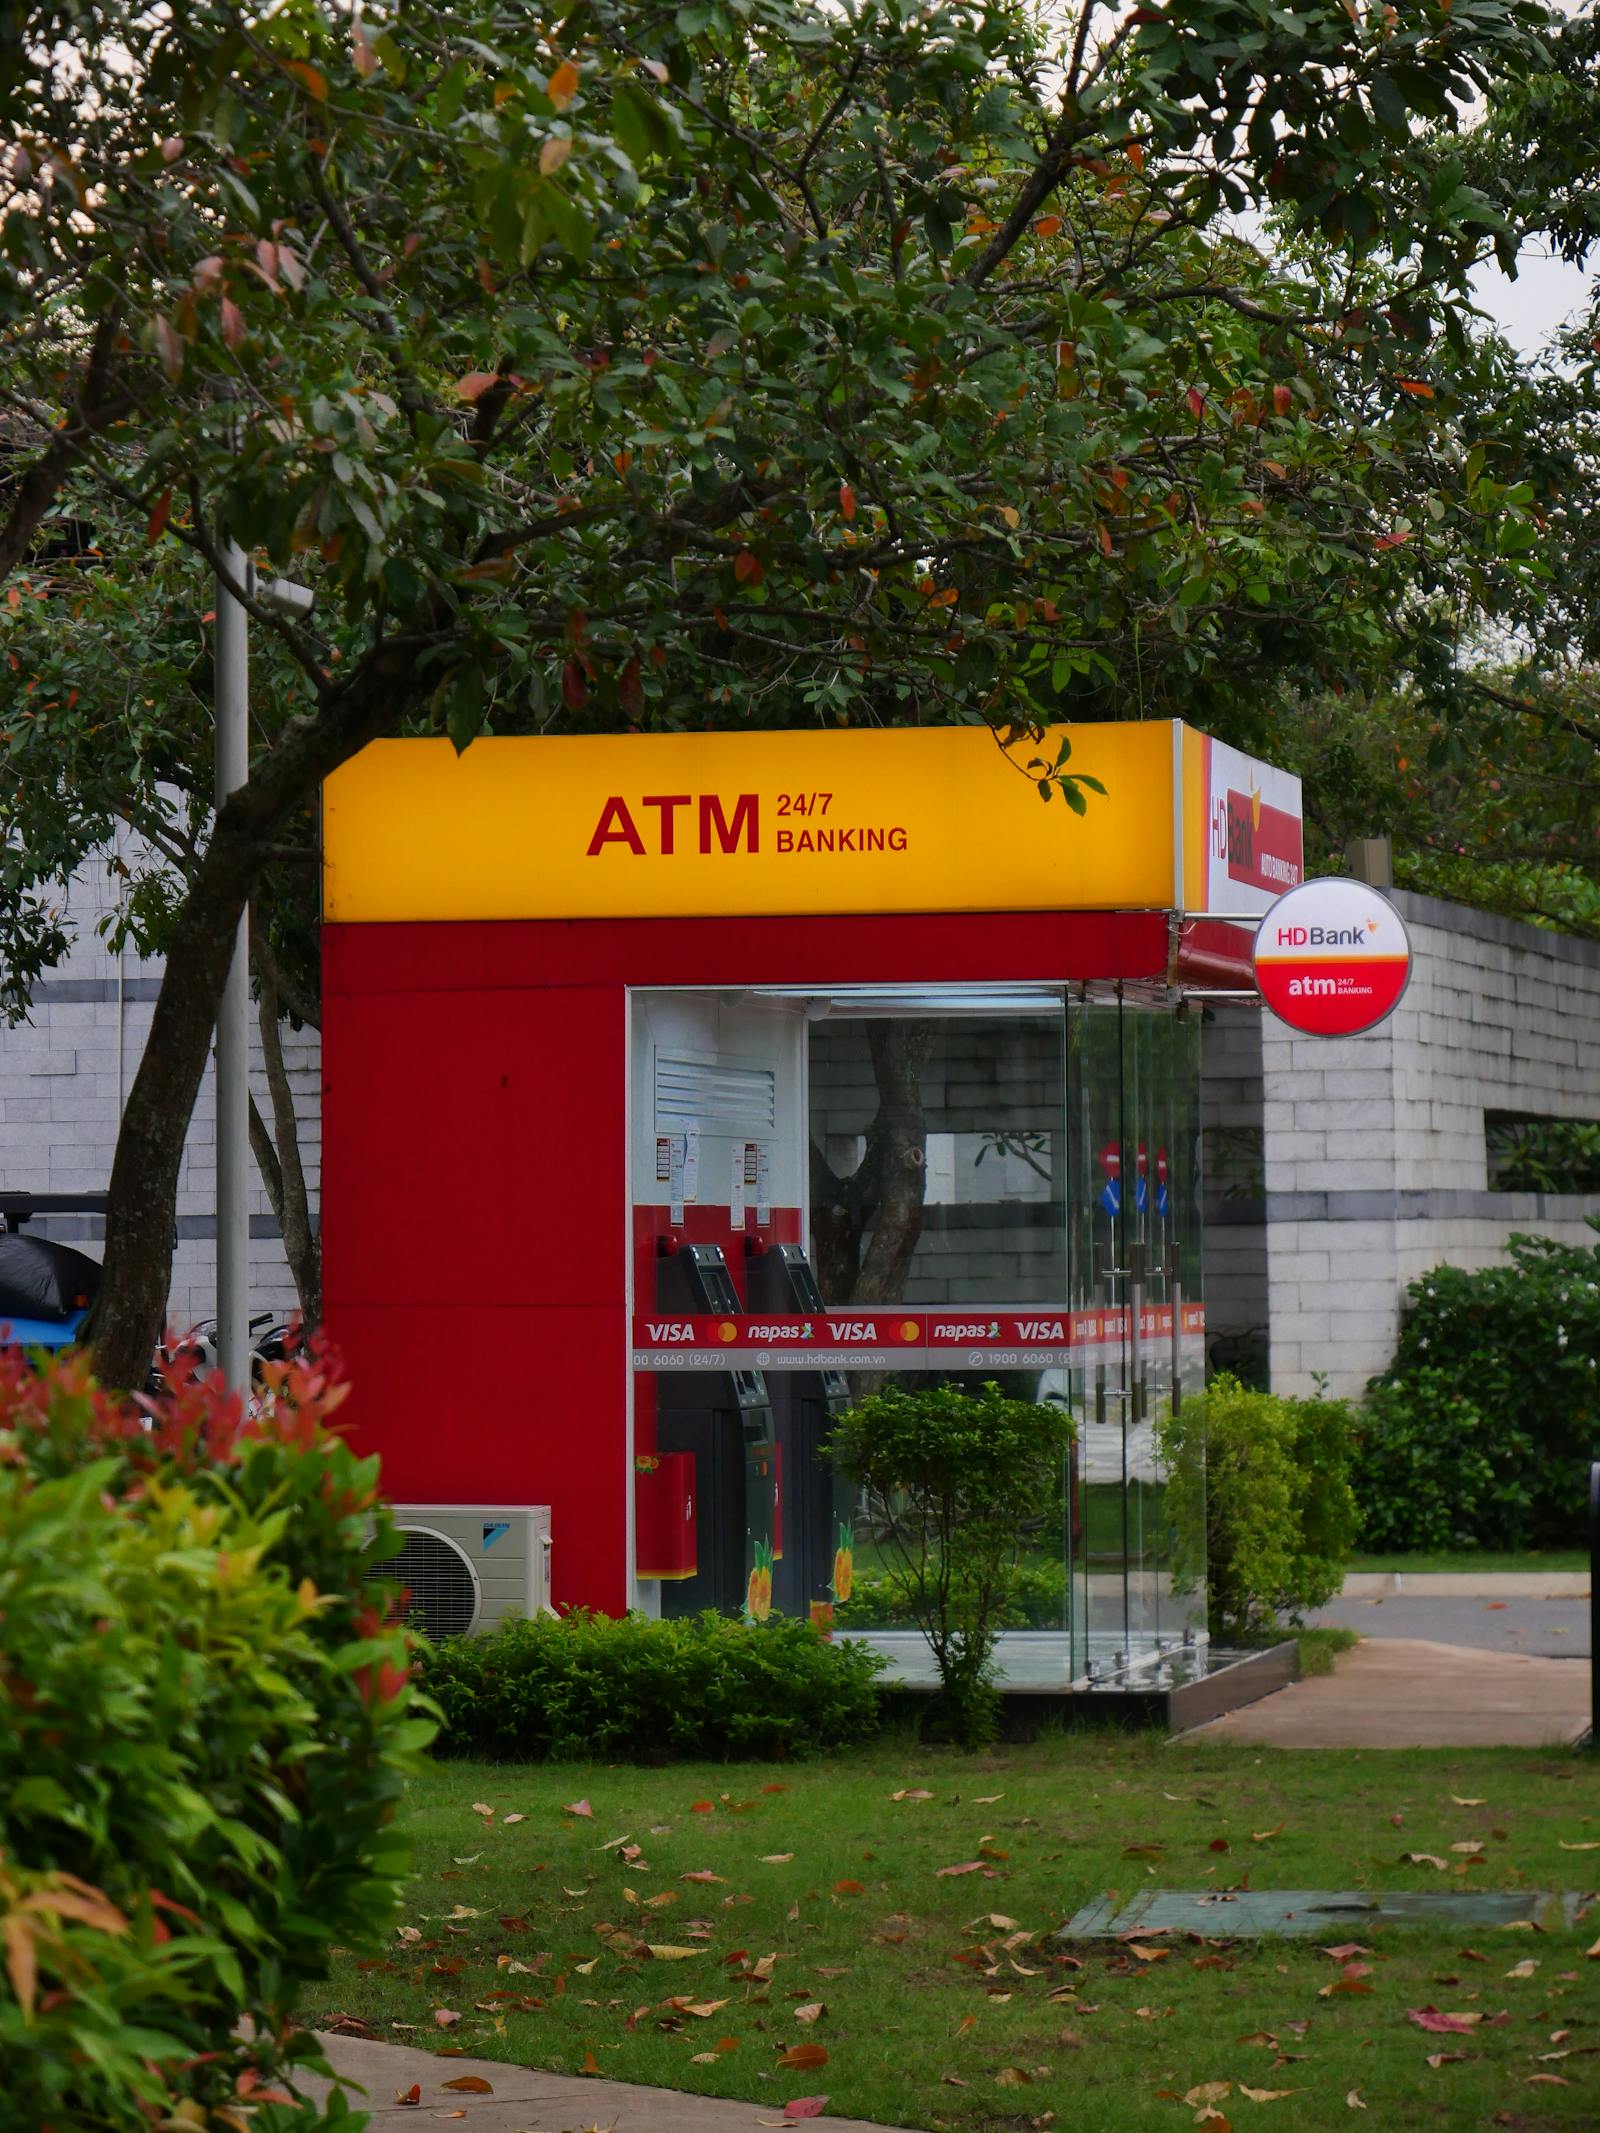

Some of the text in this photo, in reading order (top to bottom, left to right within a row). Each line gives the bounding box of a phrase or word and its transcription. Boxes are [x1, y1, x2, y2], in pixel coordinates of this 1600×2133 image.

[776, 791, 833, 817] 24/7
[586, 793, 759, 856] ATM
[776, 827, 908, 853] BANKING
[1277, 926, 1365, 946] HDBank
[1288, 975, 1337, 996] atm
[1337, 978, 1354, 986] 24/7
[1337, 986, 1373, 995] BANKING
[645, 1323, 695, 1341] VISA
[747, 1325, 800, 1342] napas
[826, 1322, 877, 1341] VISA
[934, 1324, 986, 1341] napas
[1014, 1322, 1065, 1340] VISA
[654, 1354, 684, 1366] 6060
[689, 1353, 726, 1367] (24/7)
[777, 1353, 886, 1366] www.hdbank.com.vn
[989, 1353, 1018, 1365] 1900
[1022, 1352, 1054, 1365] 6060
